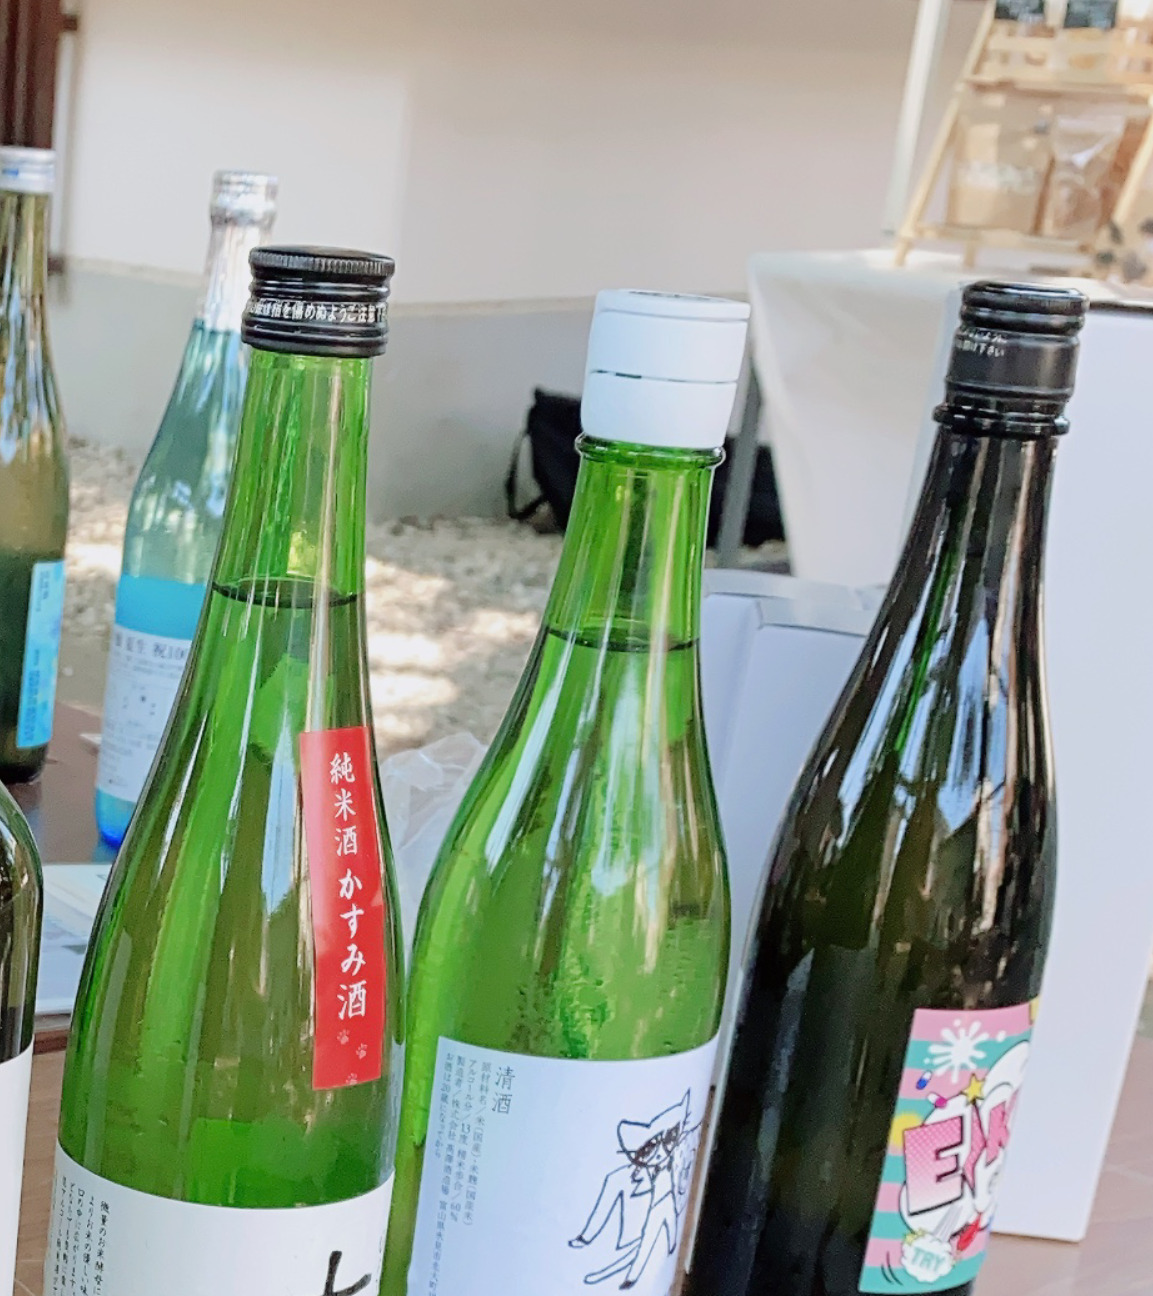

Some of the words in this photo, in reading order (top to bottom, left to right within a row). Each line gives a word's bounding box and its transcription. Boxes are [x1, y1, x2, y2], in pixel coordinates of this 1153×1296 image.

[329, 752, 358, 857] 純米酒
[336, 868, 367, 1021] かすみ酒
[491, 1066, 516, 1115] 清酒
[910, 1245, 946, 1272] TRY
